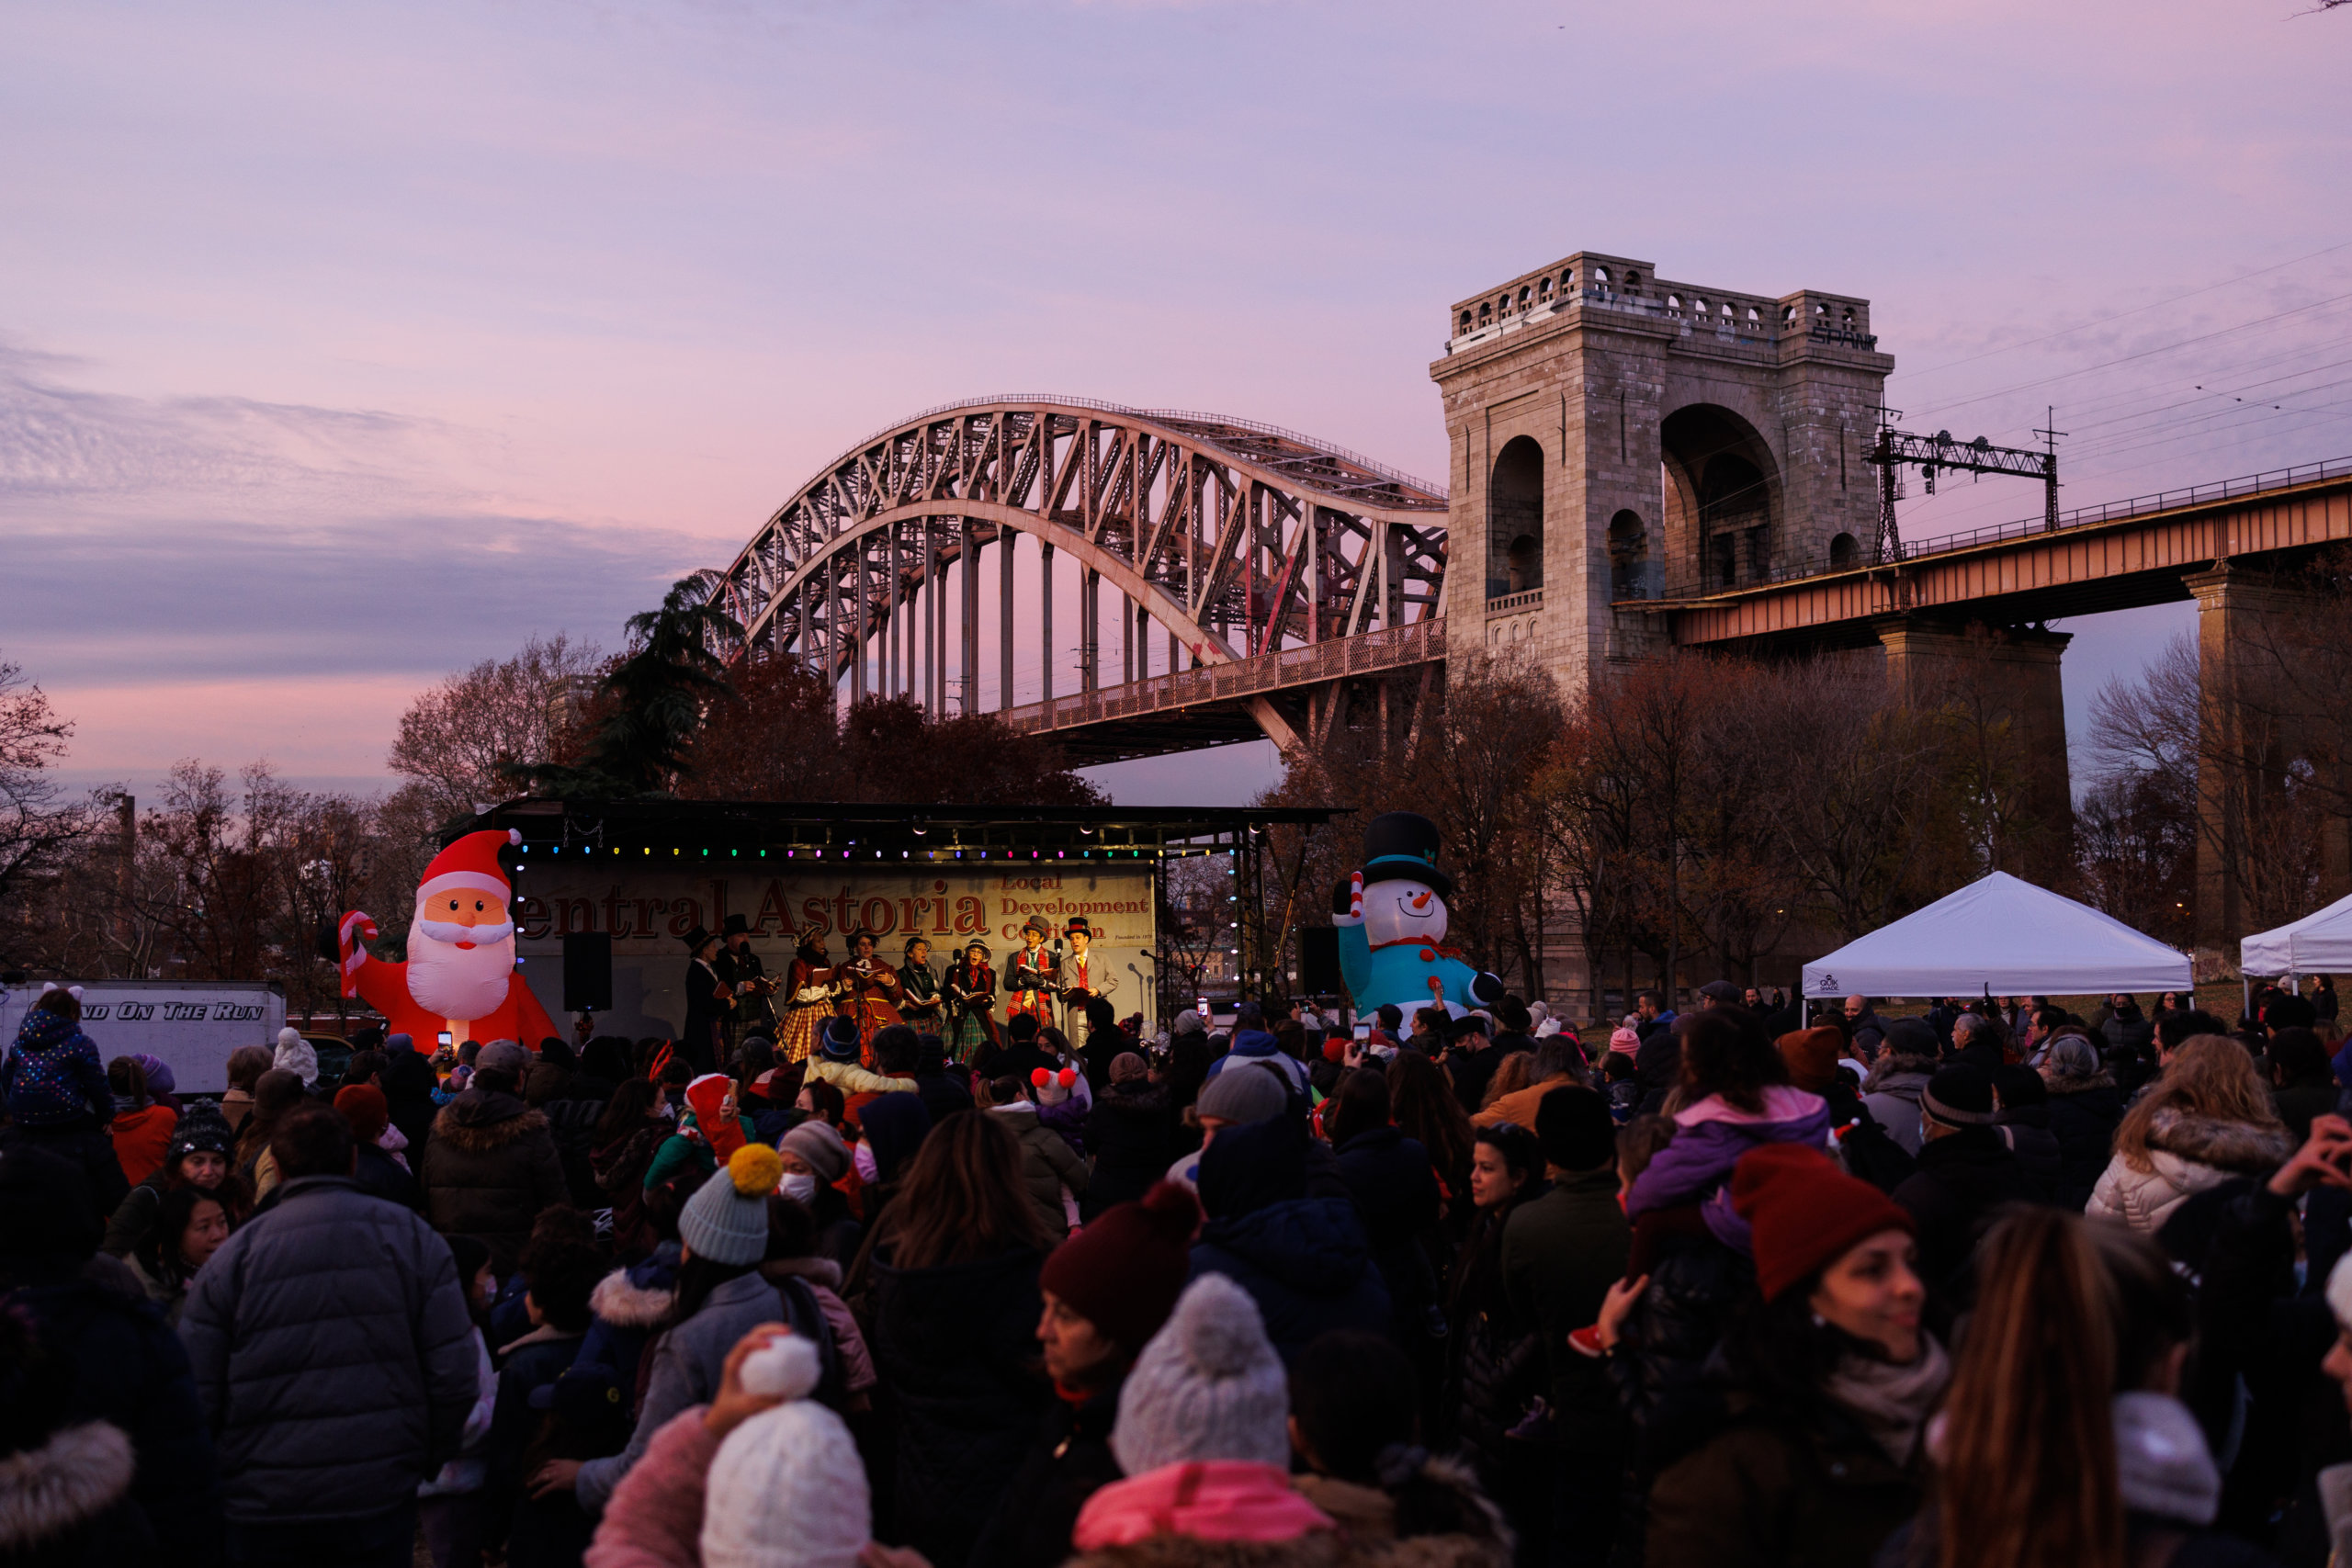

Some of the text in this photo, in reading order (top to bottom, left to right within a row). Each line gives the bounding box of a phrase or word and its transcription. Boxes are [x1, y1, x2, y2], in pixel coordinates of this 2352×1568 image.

[1808, 326, 1877, 352] SPANK
[1001, 874, 1062, 889] Local
[516, 879, 991, 940] entral Astoria
[1001, 897, 1148, 918] Development
